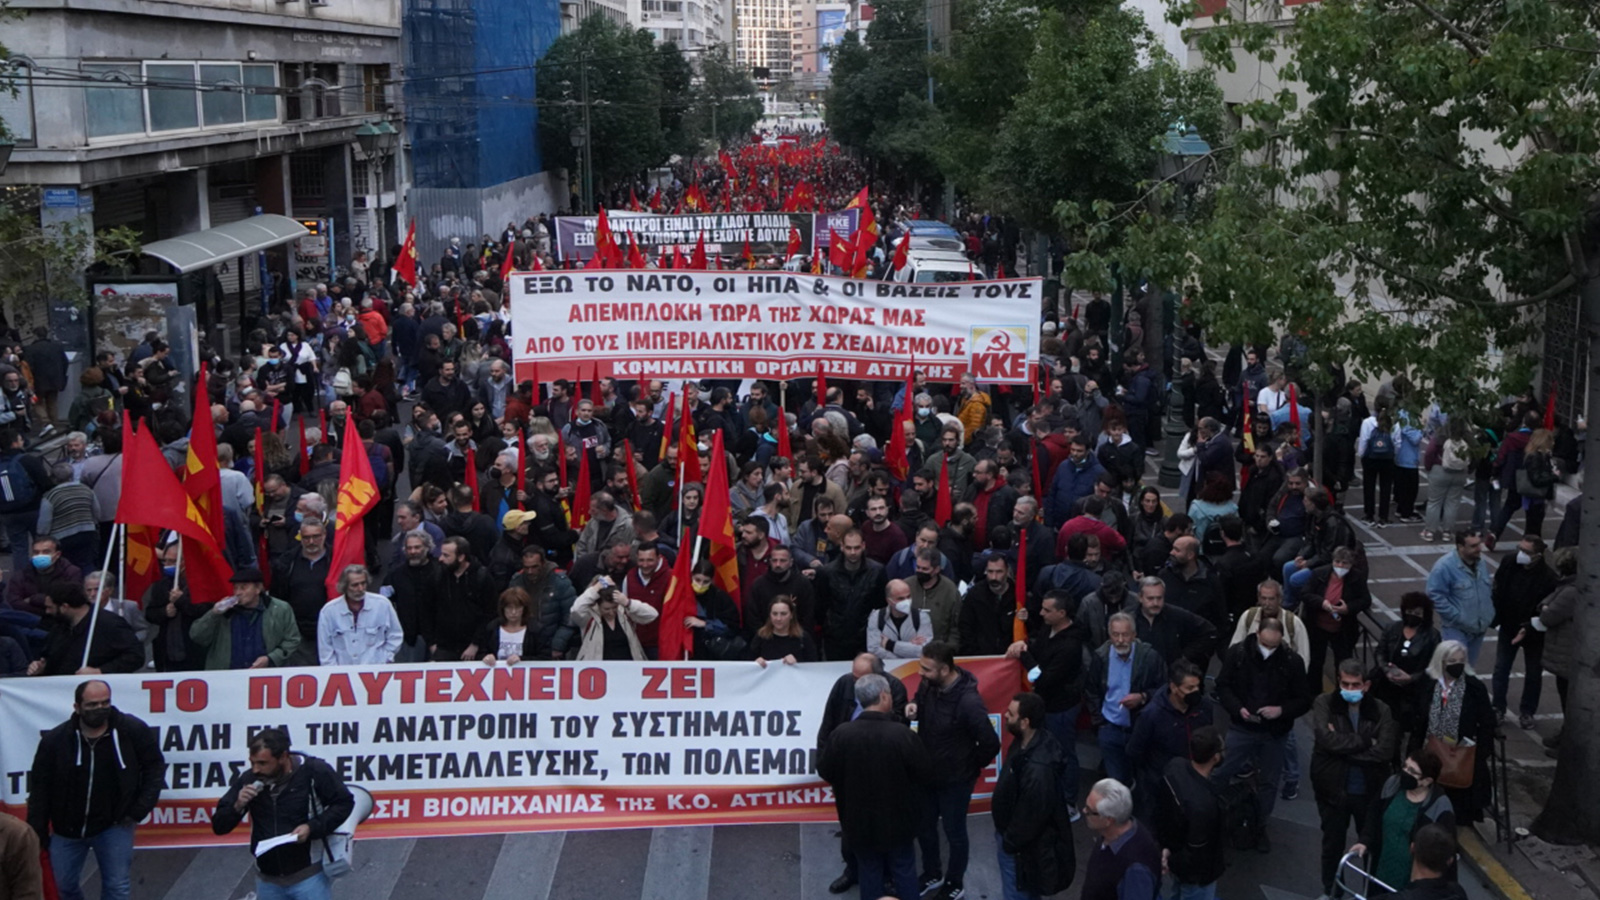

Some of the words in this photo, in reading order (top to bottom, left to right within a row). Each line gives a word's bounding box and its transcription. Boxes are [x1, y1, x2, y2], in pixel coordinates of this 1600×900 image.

[663, 217, 694, 231] ΕΙΝΑΙ
[696, 216, 717, 230] ΤΟΥ
[721, 215, 750, 229] ΛΑΟΥ
[753, 214, 791, 228] ΠΑΙΔΙΑ
[827, 217, 849, 227] ΚΚΕ
[574, 232, 594, 246] ΕΞΩ
[642, 231, 684, 244] ΣΥΝΟΡΑ
[757, 228, 802, 242] ΔΟΥΛΕ
[524, 276, 573, 294] ΕΞΩ
[585, 276, 614, 292] ΤΟ
[627, 275, 701, 296] ΝΑΤΟ,
[713, 277, 735, 292] ΟΙ
[748, 276, 800, 293] ΗΠΑ
[813, 278, 829, 296] &
[842, 282, 863, 297] ΟΙ
[876, 283, 960, 298] ΒΑΣΕΙΣ
[972, 283, 1032, 299] ΤΟΥΣ
[568, 302, 702, 323] ΑΠΕΜΠΛΟΚΗ
[709, 304, 761, 322] ΤΩΡΑ
[768, 306, 801, 323] ΤΗΣ
[809, 305, 875, 327] ΧΩΡΑΣ
[883, 308, 926, 327] ΜΑΣ
[525, 336, 565, 354] ΑΠΟ
[572, 334, 619, 351] ΤΟΥΣ
[627, 331, 815, 352] ΙΜΠΕΡΙΑΛΙΣΤΙΚΟΥΣ
[822, 333, 966, 356] ΣΧΕΔΙΑΣΜΟΥΣ
[613, 360, 745, 375] ΚΟΜΜΑΤΙΚΗ
[755, 360, 857, 376] ΟΡΓΑΝΩΣΗ
[971, 353, 1026, 379] ΚΚΕ
[142, 678, 208, 713] ΤΟ
[248, 667, 607, 710] ΠΟΛΥΤΕΧΝΕΙΟ
[641, 667, 715, 699] ΖΕΙ
[306, 721, 359, 746] ΤΗΝ
[373, 713, 537, 743] ΑΝΑΤΡΟΠΗ
[550, 715, 599, 738] ΤΟΥ
[612, 710, 801, 738] ΣΥΣΤΗΜΑΤΟΣ
[336, 749, 608, 782] ΕΚΜΕΤΑΛΛΕΥΣΗΣ,
[622, 752, 670, 775] ΤΩΝ
[423, 794, 605, 818] ΒΙΟΜΗΧΑΝΙΑΣ
[616, 798, 655, 811] ΤΗΣ
[667, 795, 718, 810] Κ.Ο.
[730, 785, 836, 807] ΑΤΤΙΚΗΣ
